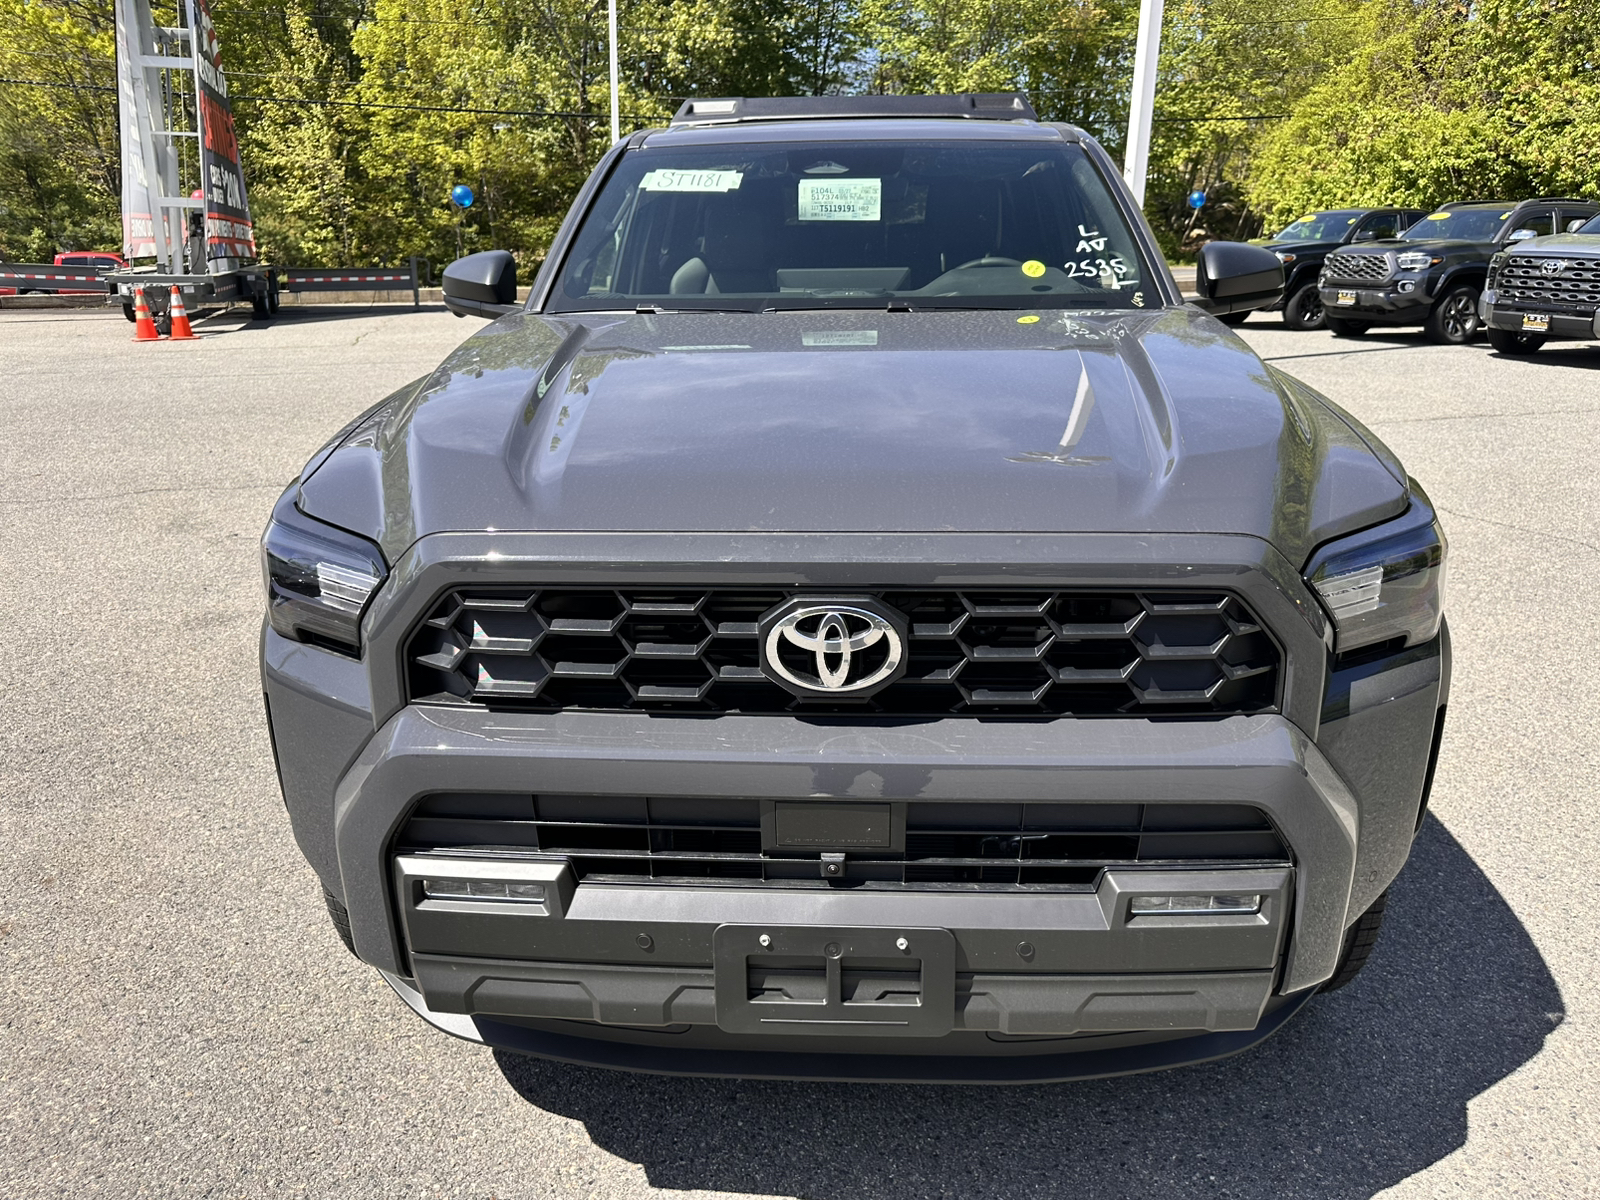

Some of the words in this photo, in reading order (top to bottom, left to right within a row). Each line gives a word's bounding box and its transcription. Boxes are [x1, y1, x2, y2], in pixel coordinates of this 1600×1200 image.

[657, 171, 722, 188] ST1181
[820, 204, 855, 213] T5119191
[1064, 258, 1127, 278] 2535
